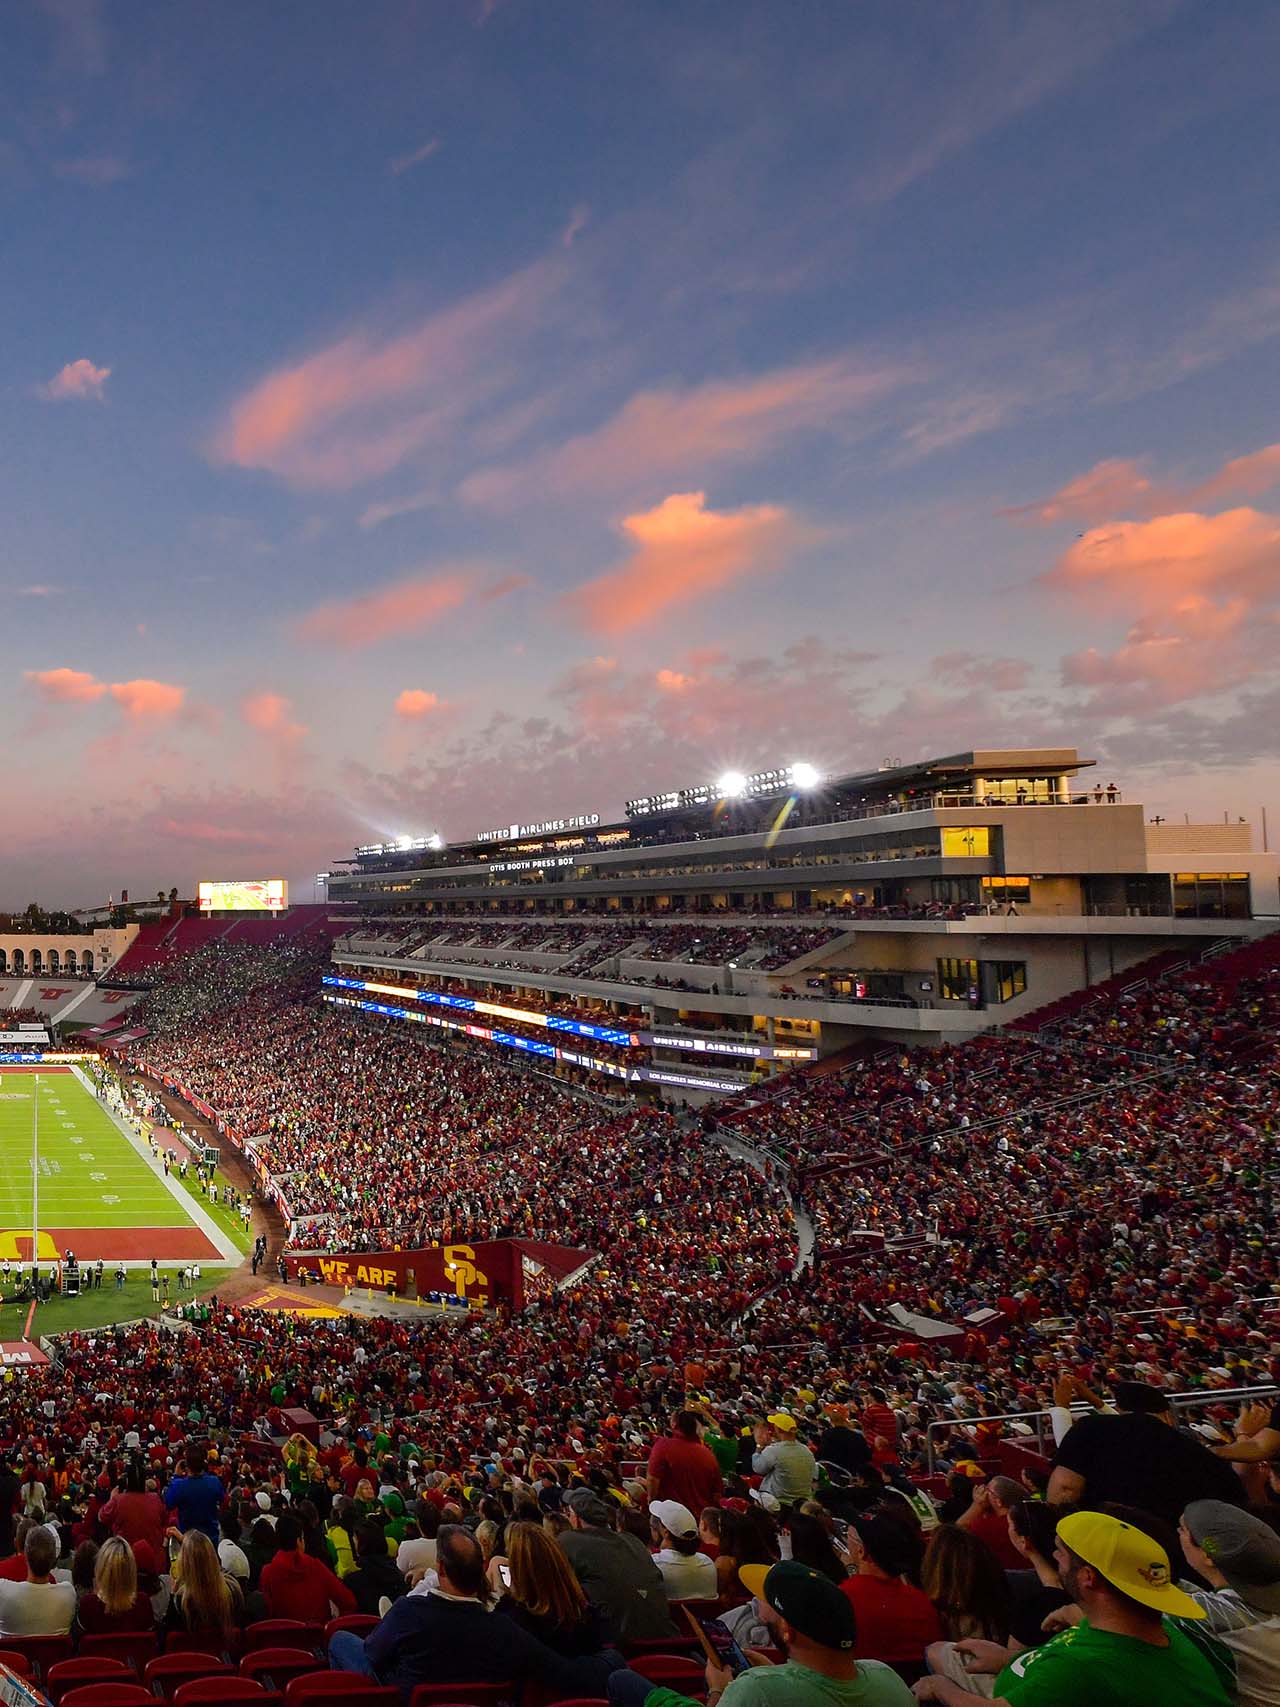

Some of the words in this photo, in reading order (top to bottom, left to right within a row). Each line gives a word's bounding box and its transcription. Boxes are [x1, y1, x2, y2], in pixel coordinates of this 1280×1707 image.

[477, 829, 509, 841] UNITED
[520, 820, 564, 835] AIRLINES
[569, 814, 599, 827] FIELD
[490, 864, 505, 872] OTIS
[507, 861, 530, 871] BOOTH
[532, 859, 556, 868] PRESS
[558, 857, 574, 866] BOX
[653, 1037, 693, 1048] UNITED
[706, 1043, 761, 1056] AIRLINES
[661, 1075, 687, 1083] ANGELES
[687, 1078, 721, 1089] MEMORIAL
[319, 1258, 349, 1275] WE
[357, 1265, 397, 1286] ARE
